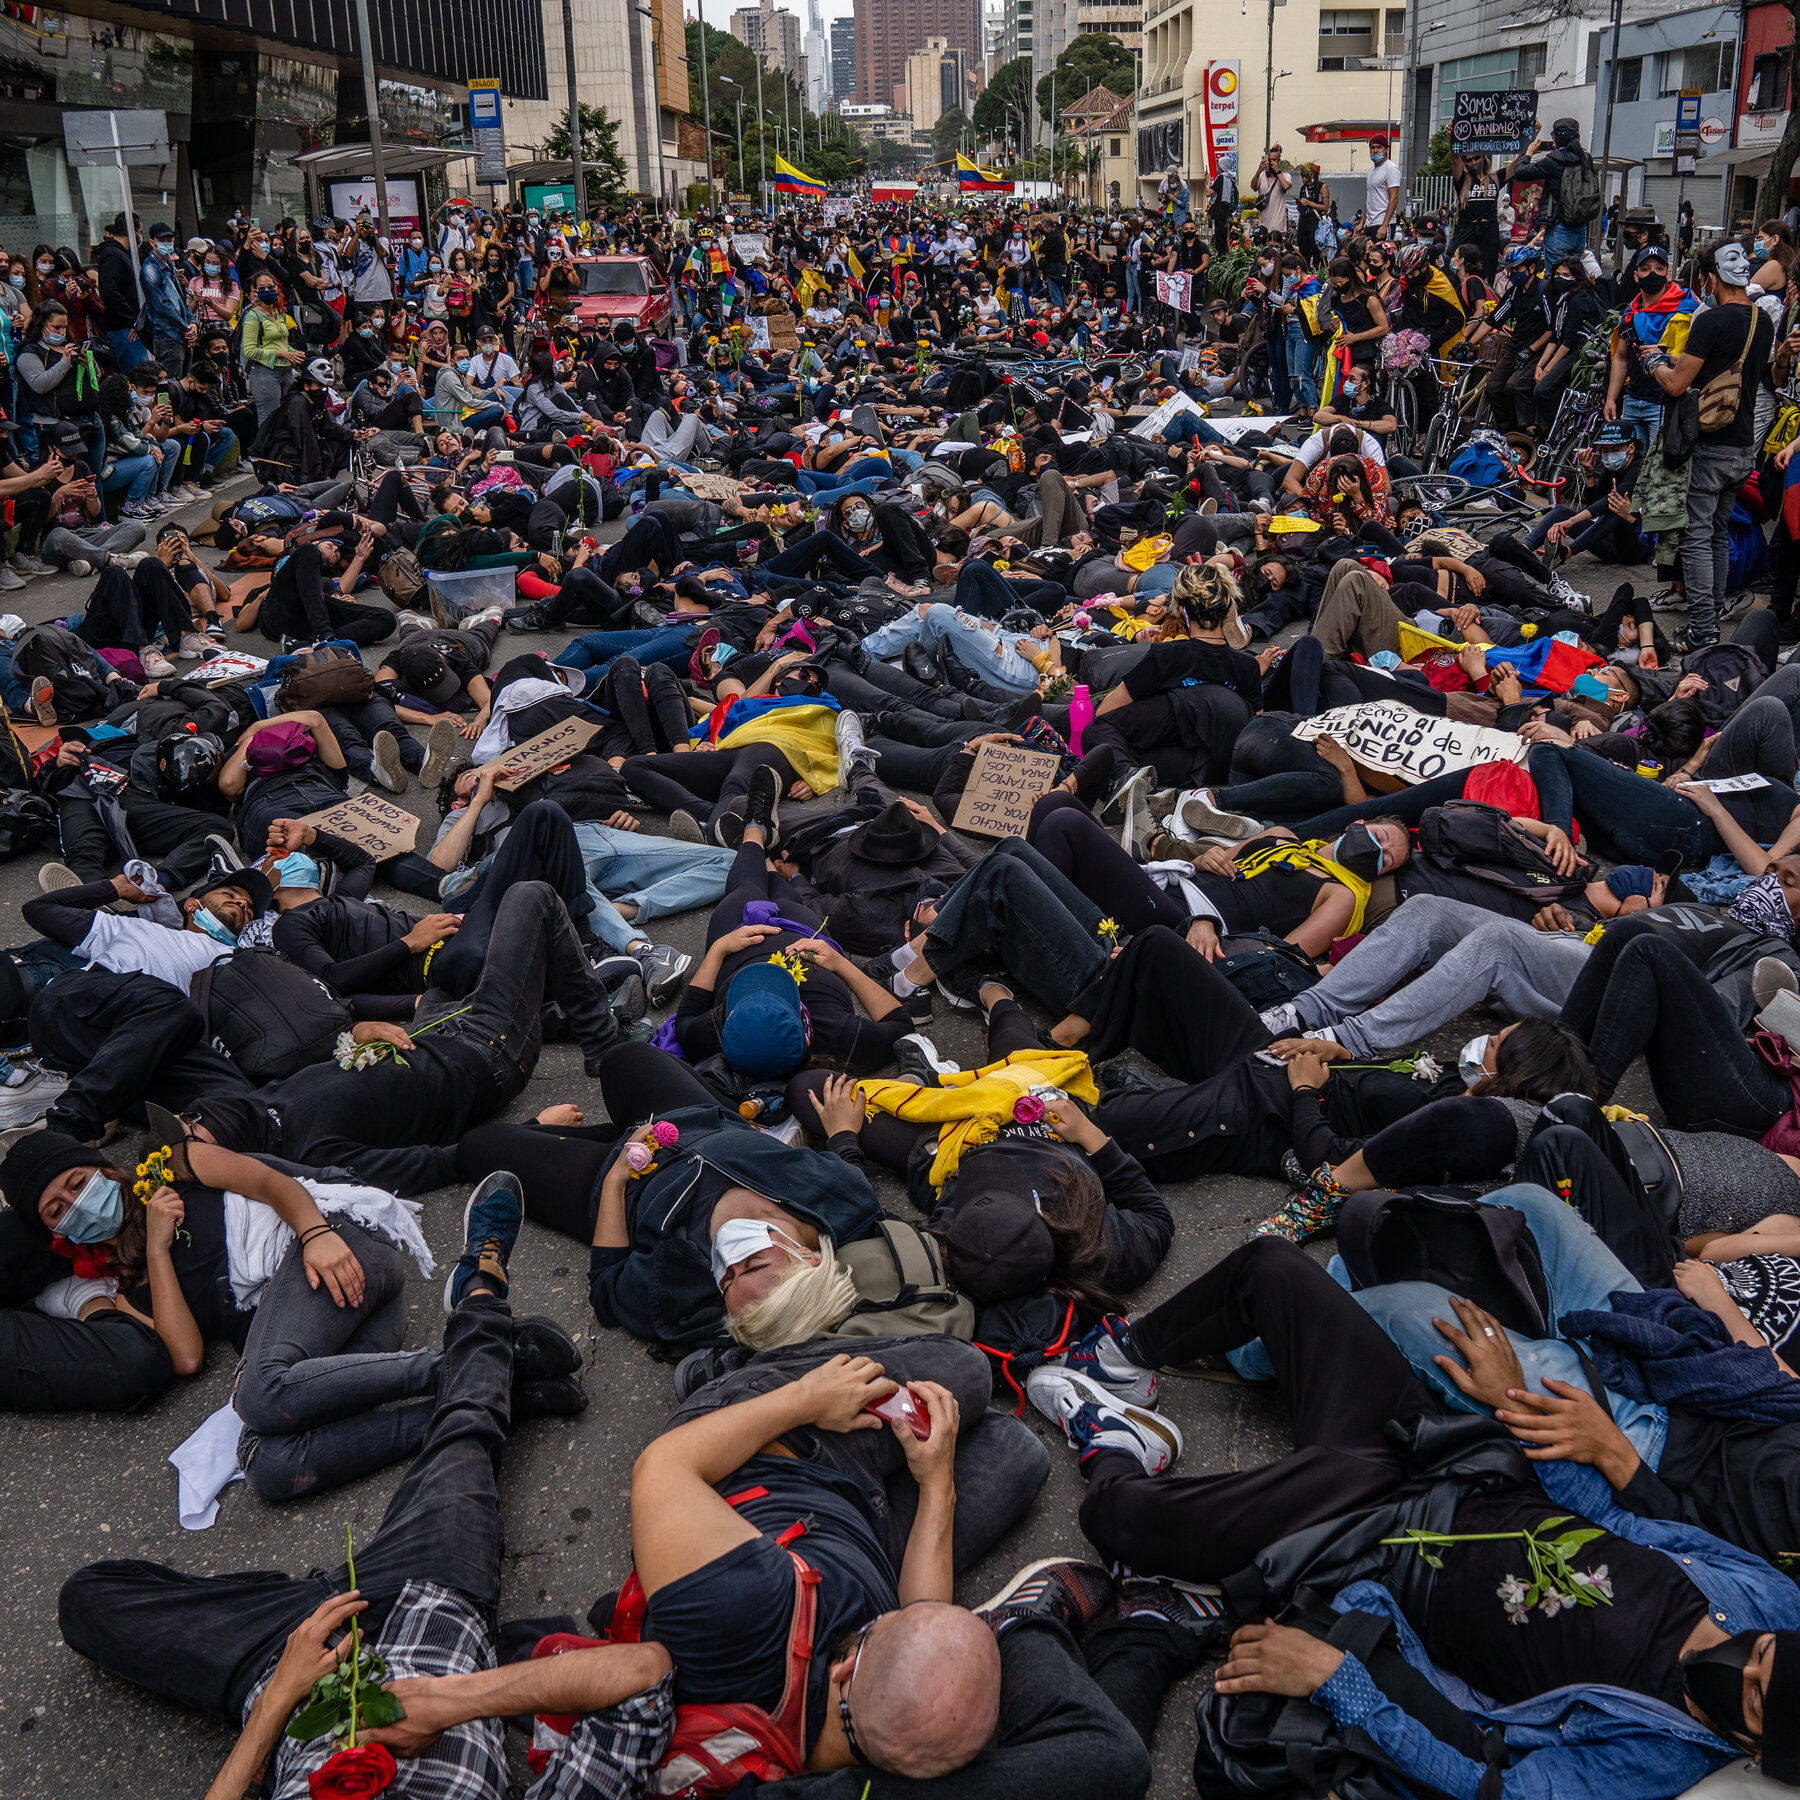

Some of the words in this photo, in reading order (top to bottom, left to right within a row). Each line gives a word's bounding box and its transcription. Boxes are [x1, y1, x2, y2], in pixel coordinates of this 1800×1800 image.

[1210, 101, 1236, 112] terpel
[1457, 93, 1500, 117] SOMOS
[1472, 119, 1520, 140] VANDALOS
[1216, 137, 1235, 146] gazel
[504, 725, 577, 768] ATARNOS
[1432, 731, 1463, 756] de
[1469, 746, 1500, 760] mi
[983, 747, 1027, 764] VIENEN
[1030, 757, 1055, 769] QUE
[987, 761, 1013, 773] LOS
[1021, 767, 1051, 780] PARA
[981, 771, 1045, 792] ESTAMOS
[986, 788, 1021, 805] QUE
[972, 801, 997, 813] LOS
[1004, 806, 1030, 821] POR
[969, 815, 1025, 836] MARCHO
